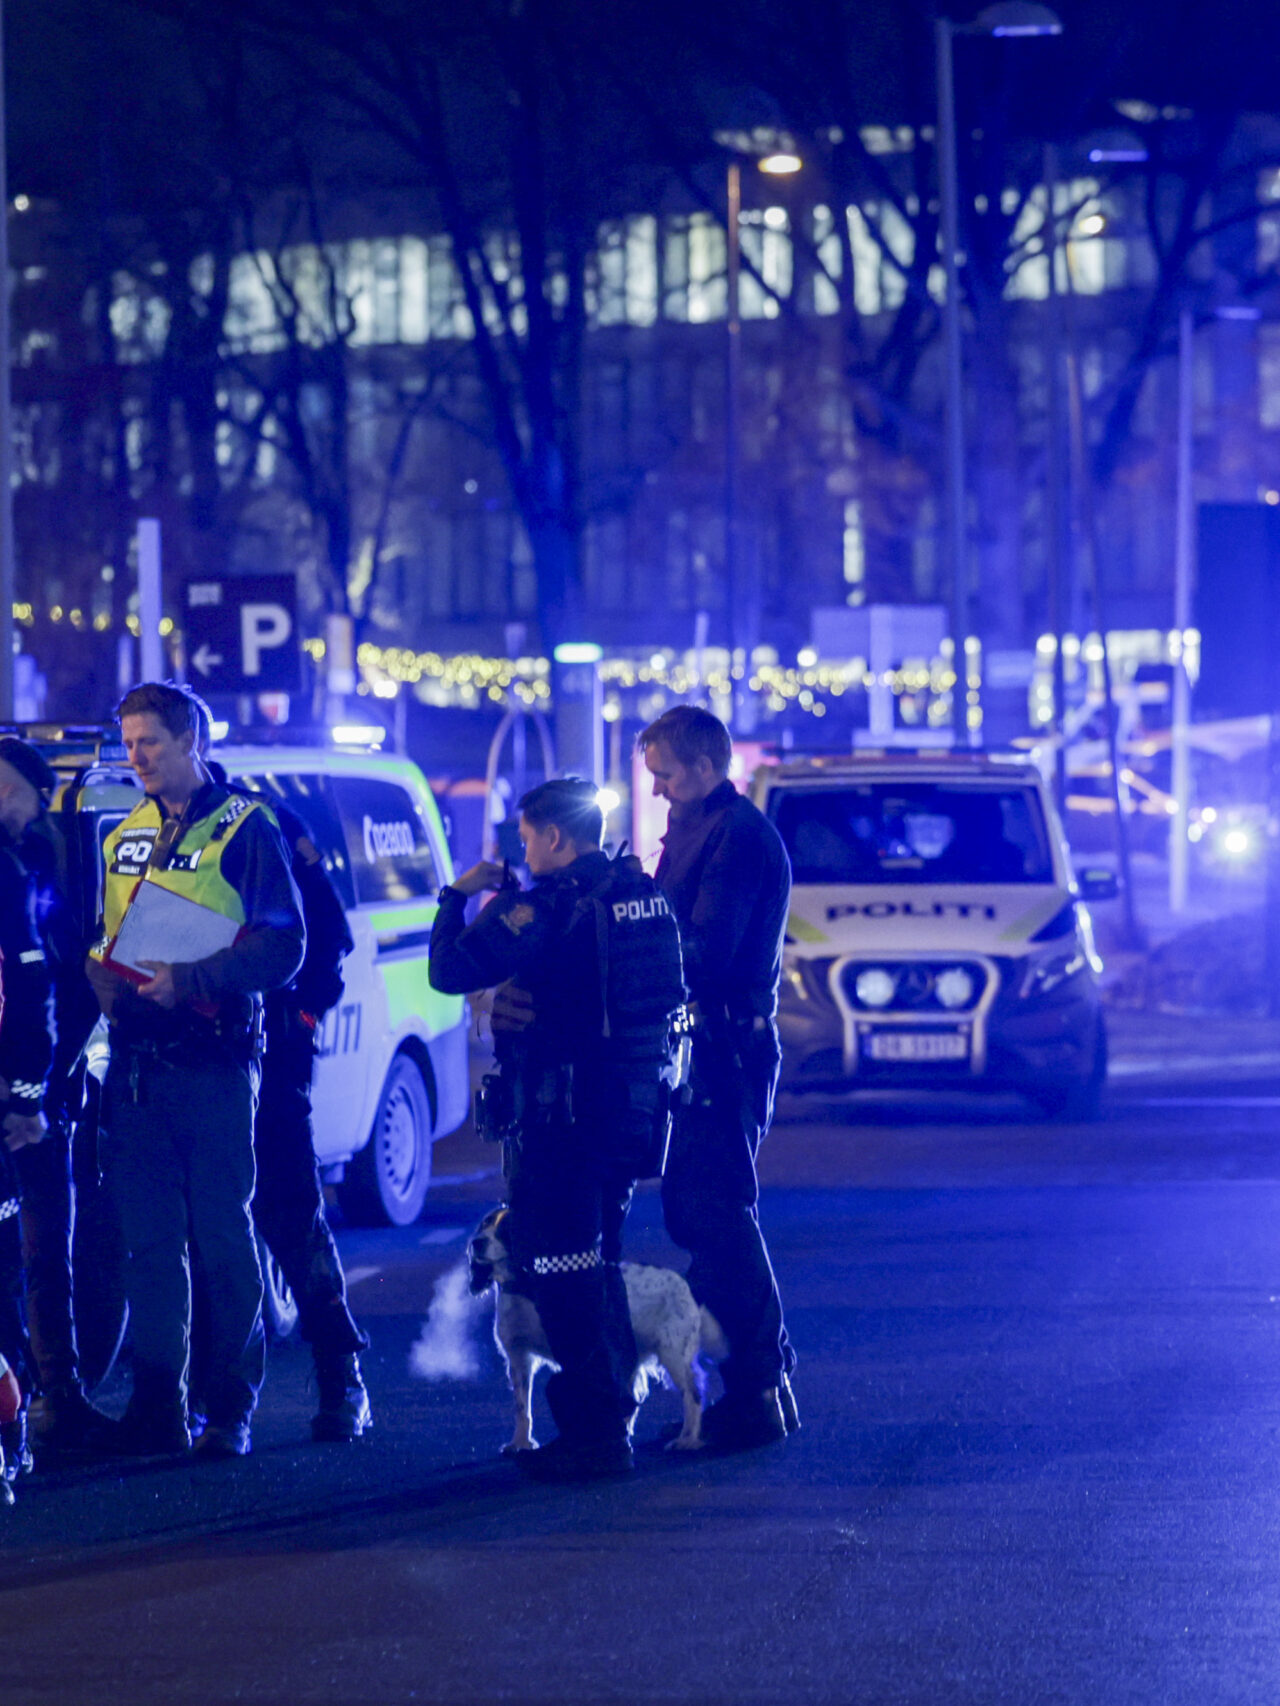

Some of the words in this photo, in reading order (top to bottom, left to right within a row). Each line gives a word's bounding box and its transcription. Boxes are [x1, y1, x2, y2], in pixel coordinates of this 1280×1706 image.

[241, 603, 291, 676] P
[117, 840, 202, 872] POI
[612, 897, 669, 922] POLITI
[825, 902, 996, 921] POLITI
